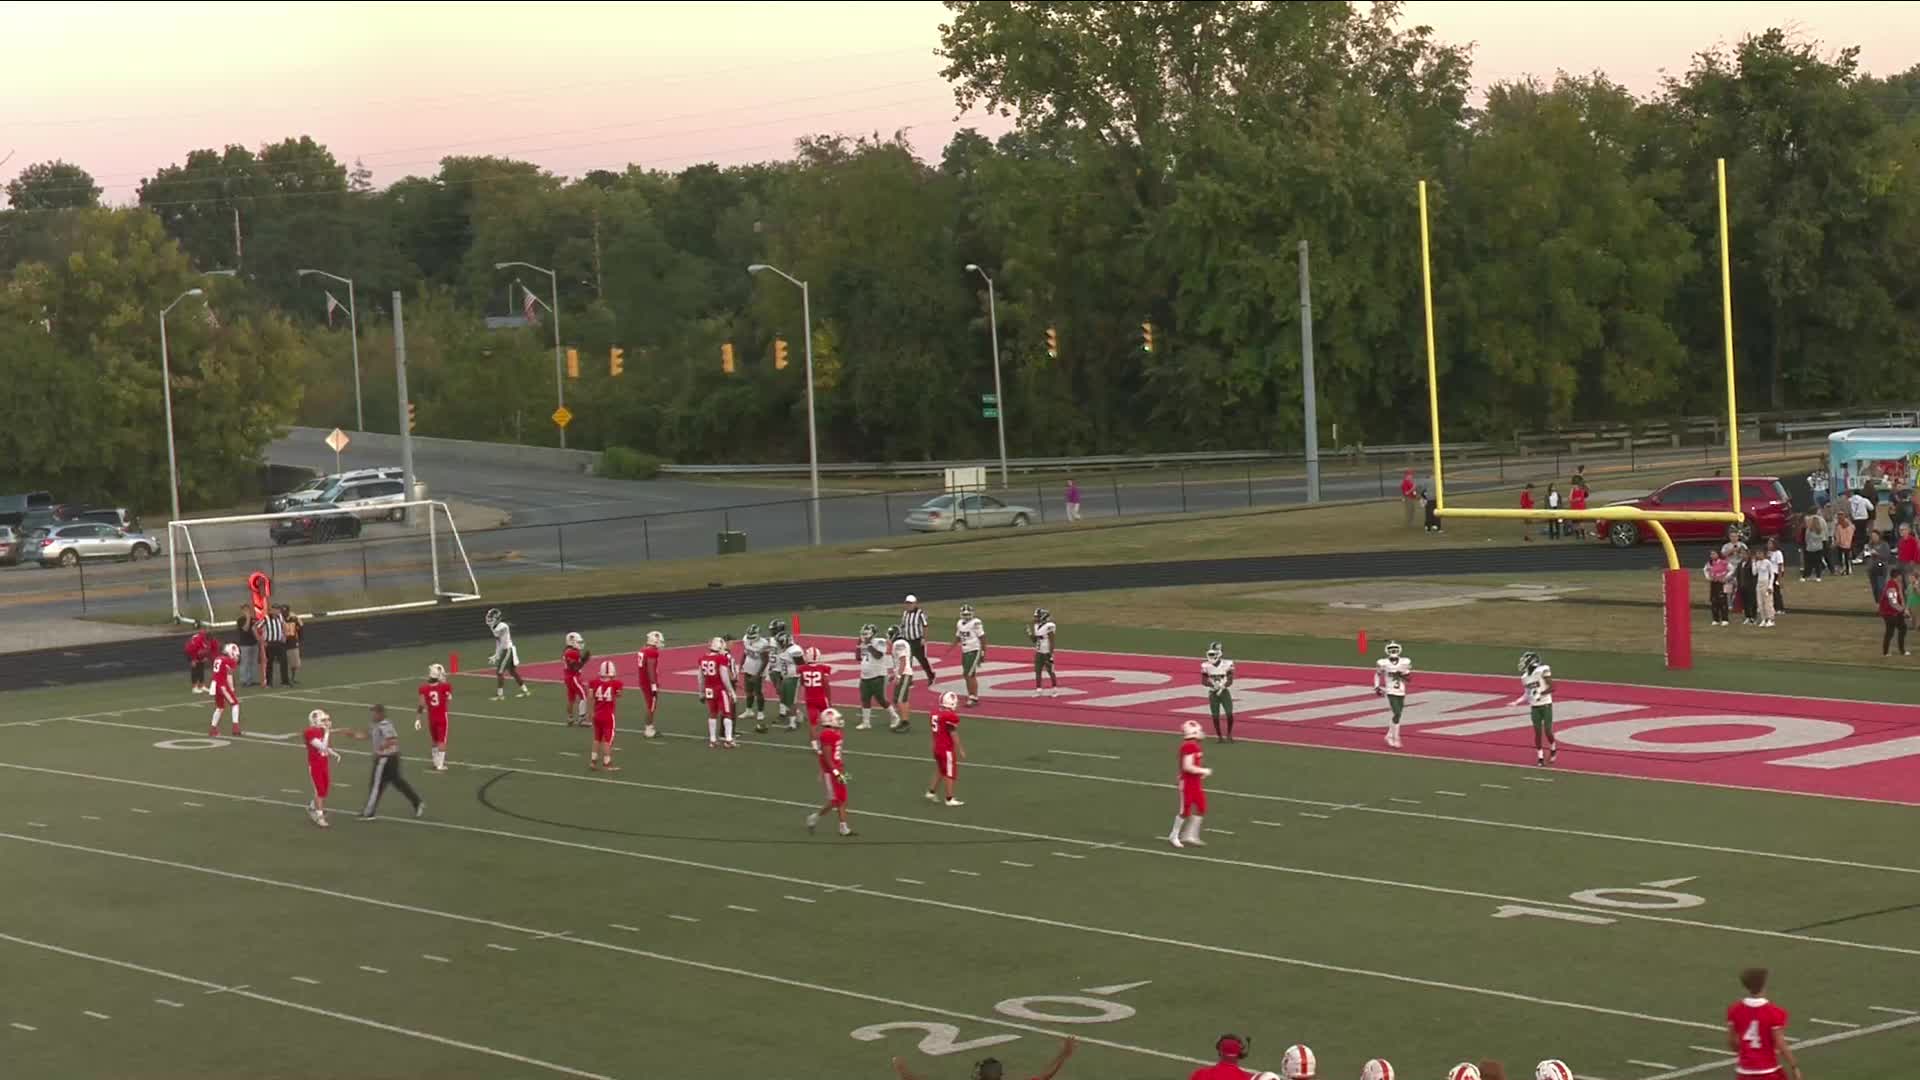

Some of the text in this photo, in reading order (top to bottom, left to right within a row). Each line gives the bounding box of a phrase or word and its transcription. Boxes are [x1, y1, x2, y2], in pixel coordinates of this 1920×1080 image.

[803, 671, 822, 687] 52
[429, 691, 440, 706] 3
[595, 685, 612, 702] 44
[672, 650, 1920, 769] ICHMO
[931, 715, 939, 732] 5
[1490, 888, 1706, 925] 10
[850, 995, 1136, 1055] 20
[1742, 1020, 1762, 1049] 4
